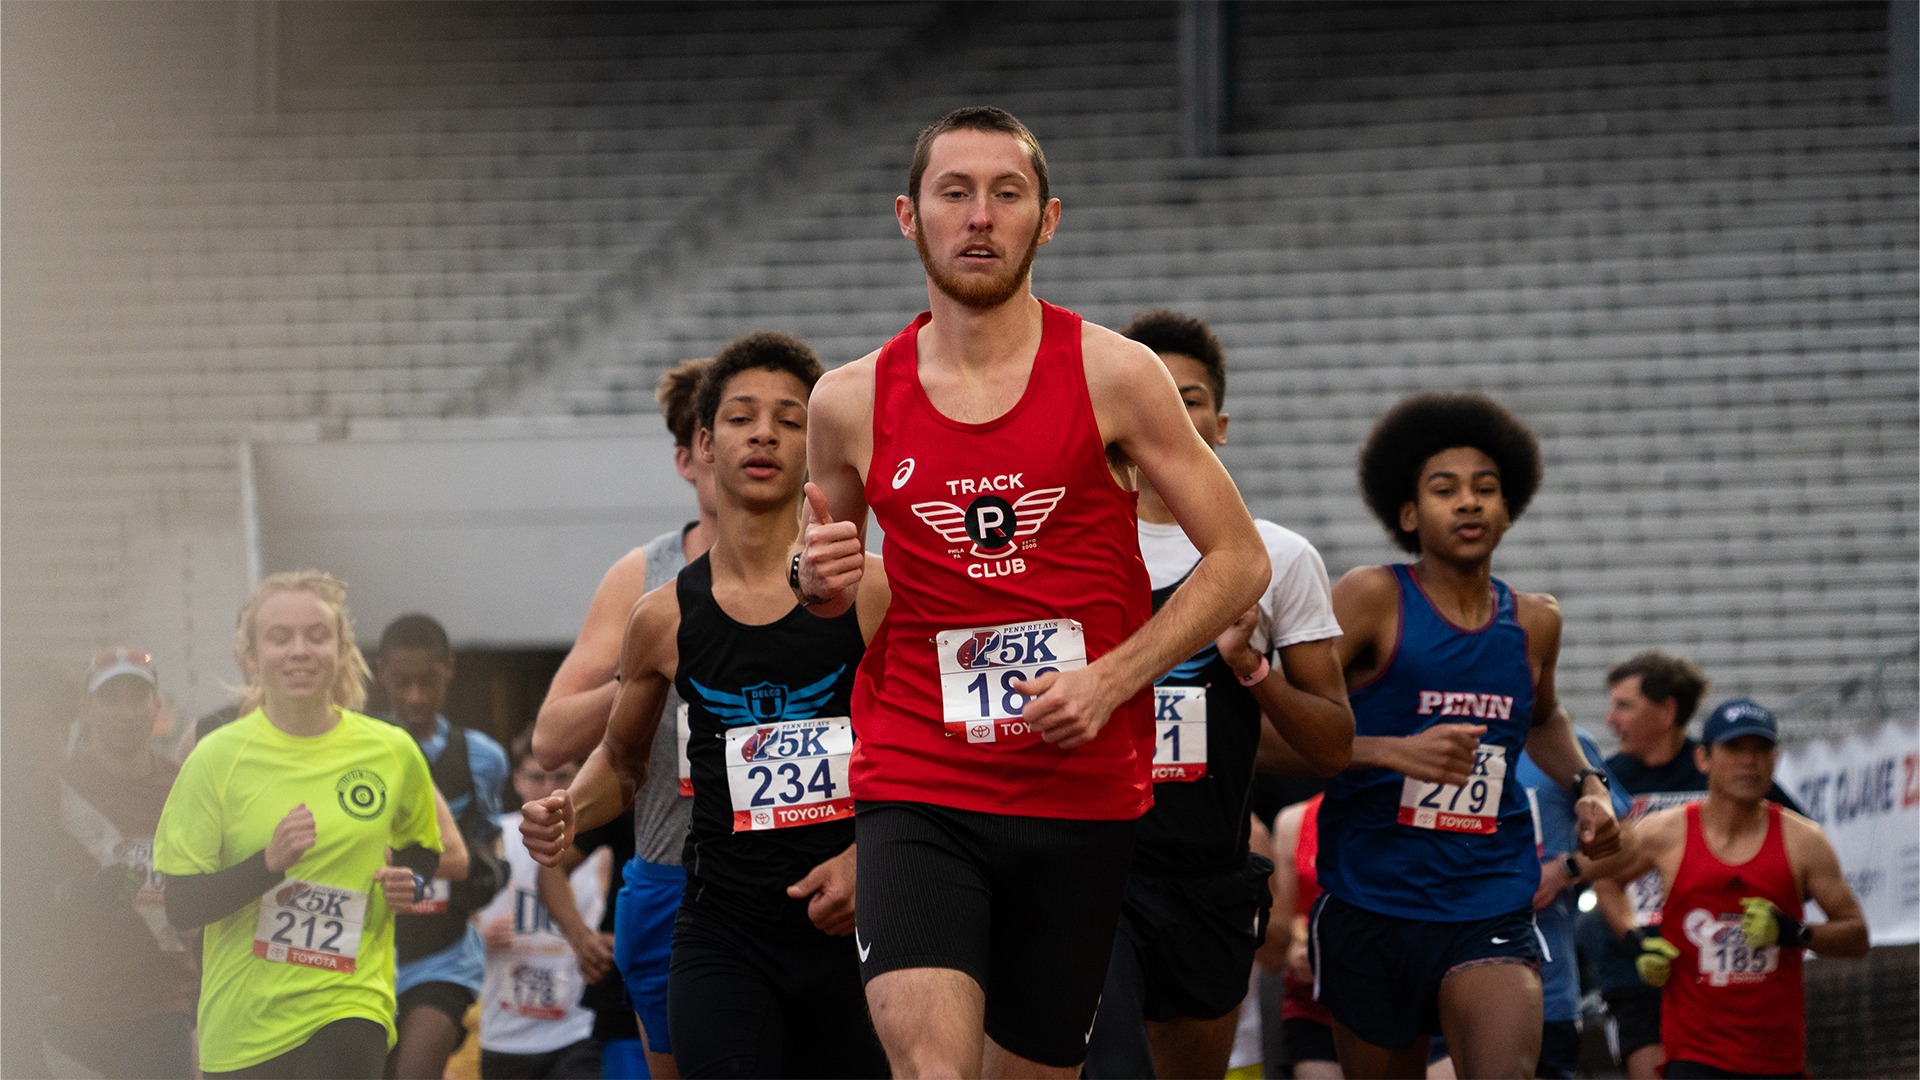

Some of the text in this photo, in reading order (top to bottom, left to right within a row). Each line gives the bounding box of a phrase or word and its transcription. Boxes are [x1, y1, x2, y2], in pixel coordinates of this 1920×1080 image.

[946, 473, 1025, 496] TRACK
[967, 558, 1027, 578] CLUB
[1003, 621, 1058, 634] PENN RELAYS
[751, 688, 781, 699] DELCO
[968, 666, 1061, 718] 18
[751, 697, 782, 719] U
[1155, 695, 1186, 721] K
[1417, 690, 1514, 721] PENN
[803, 720, 830, 728] RELAYS
[1001, 722, 1032, 736] TOY
[1152, 767, 1186, 779] YOTA
[1472, 752, 1494, 776] K
[747, 758, 836, 807] 234
[1419, 780, 1488, 814] 279
[778, 803, 836, 823] TOYOTA
[1439, 815, 1483, 830] TOYOTA
[271, 911, 345, 954] 212
[291, 950, 338, 968] TOYOTA
[1716, 947, 1767, 973] 185
